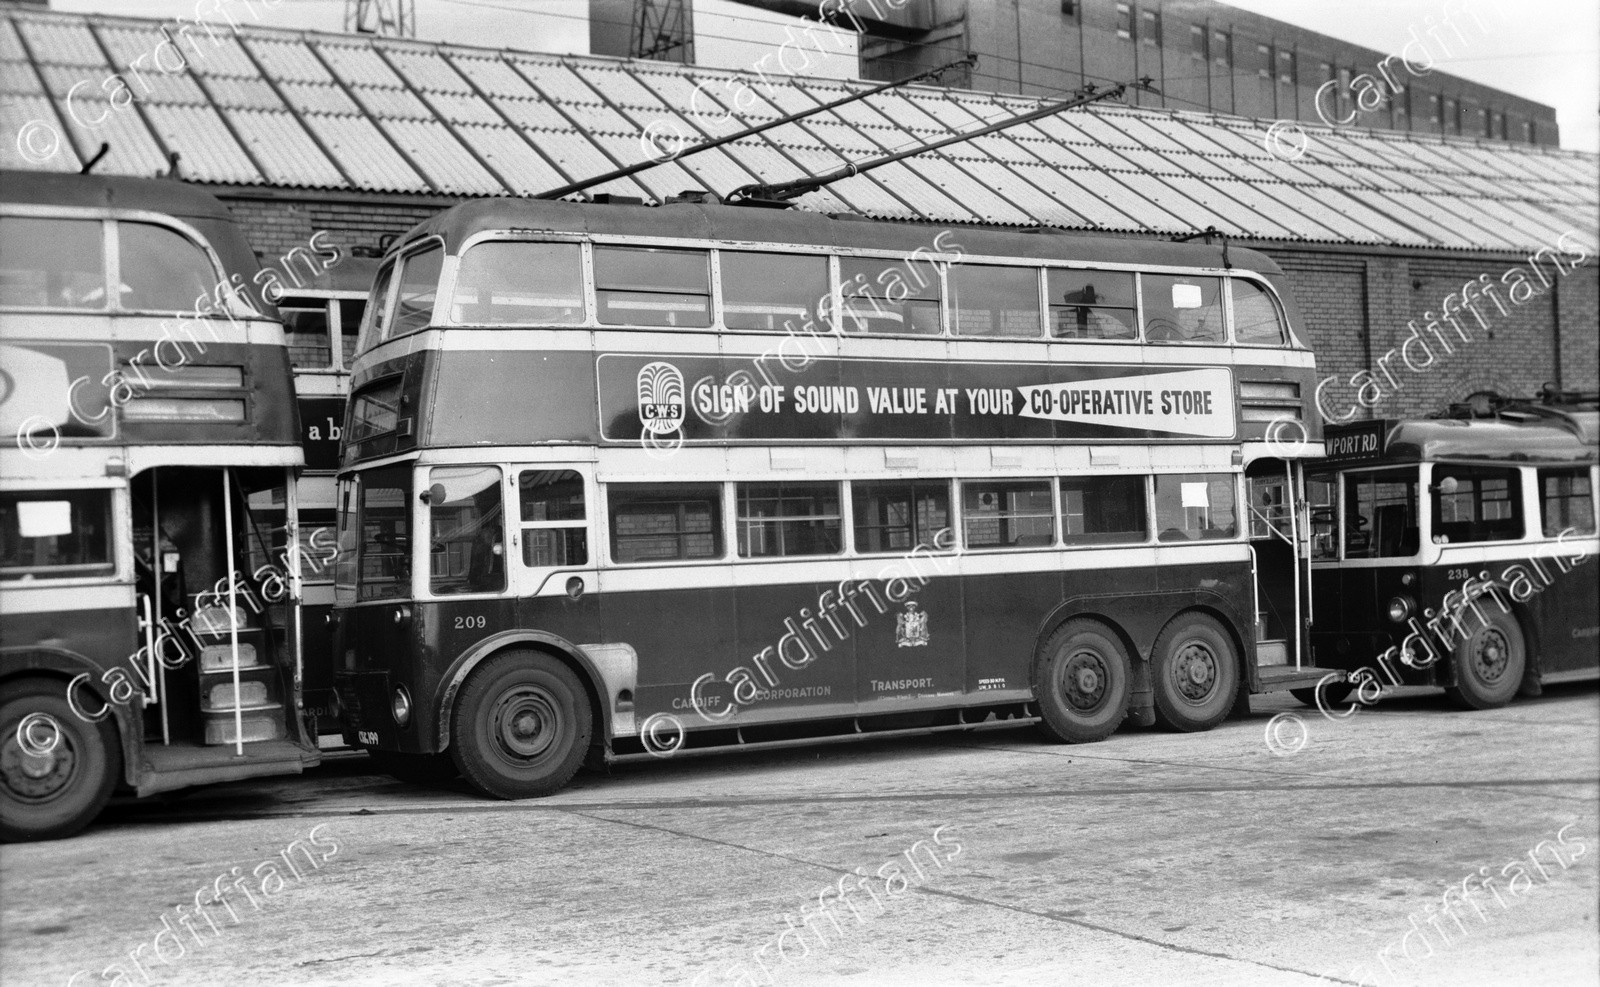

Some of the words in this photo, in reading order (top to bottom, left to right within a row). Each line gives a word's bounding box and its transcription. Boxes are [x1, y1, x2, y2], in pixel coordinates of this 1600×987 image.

[698, 384, 749, 413] SIGN
[759, 385, 785, 413] OF
[793, 385, 859, 414] SOUND
[866, 387, 927, 414] VALUE
[934, 388, 959, 415] AT
[965, 388, 1014, 415] YOUR
[1030, 388, 1153, 415] CO-OPERATIVE
[1160, 390, 1213, 415] STORE
[308, 425, 322, 441] a
[326, 416, 344, 441] b
[1361, 433, 1378, 452] RD.
[1448, 568, 1469, 580] 238
[454, 615, 487, 629] 209
[671, 695, 722, 710] CARDIFF
[754, 683, 832, 701] CORPORATION
[870, 677, 935, 692] TRANSPORT.
